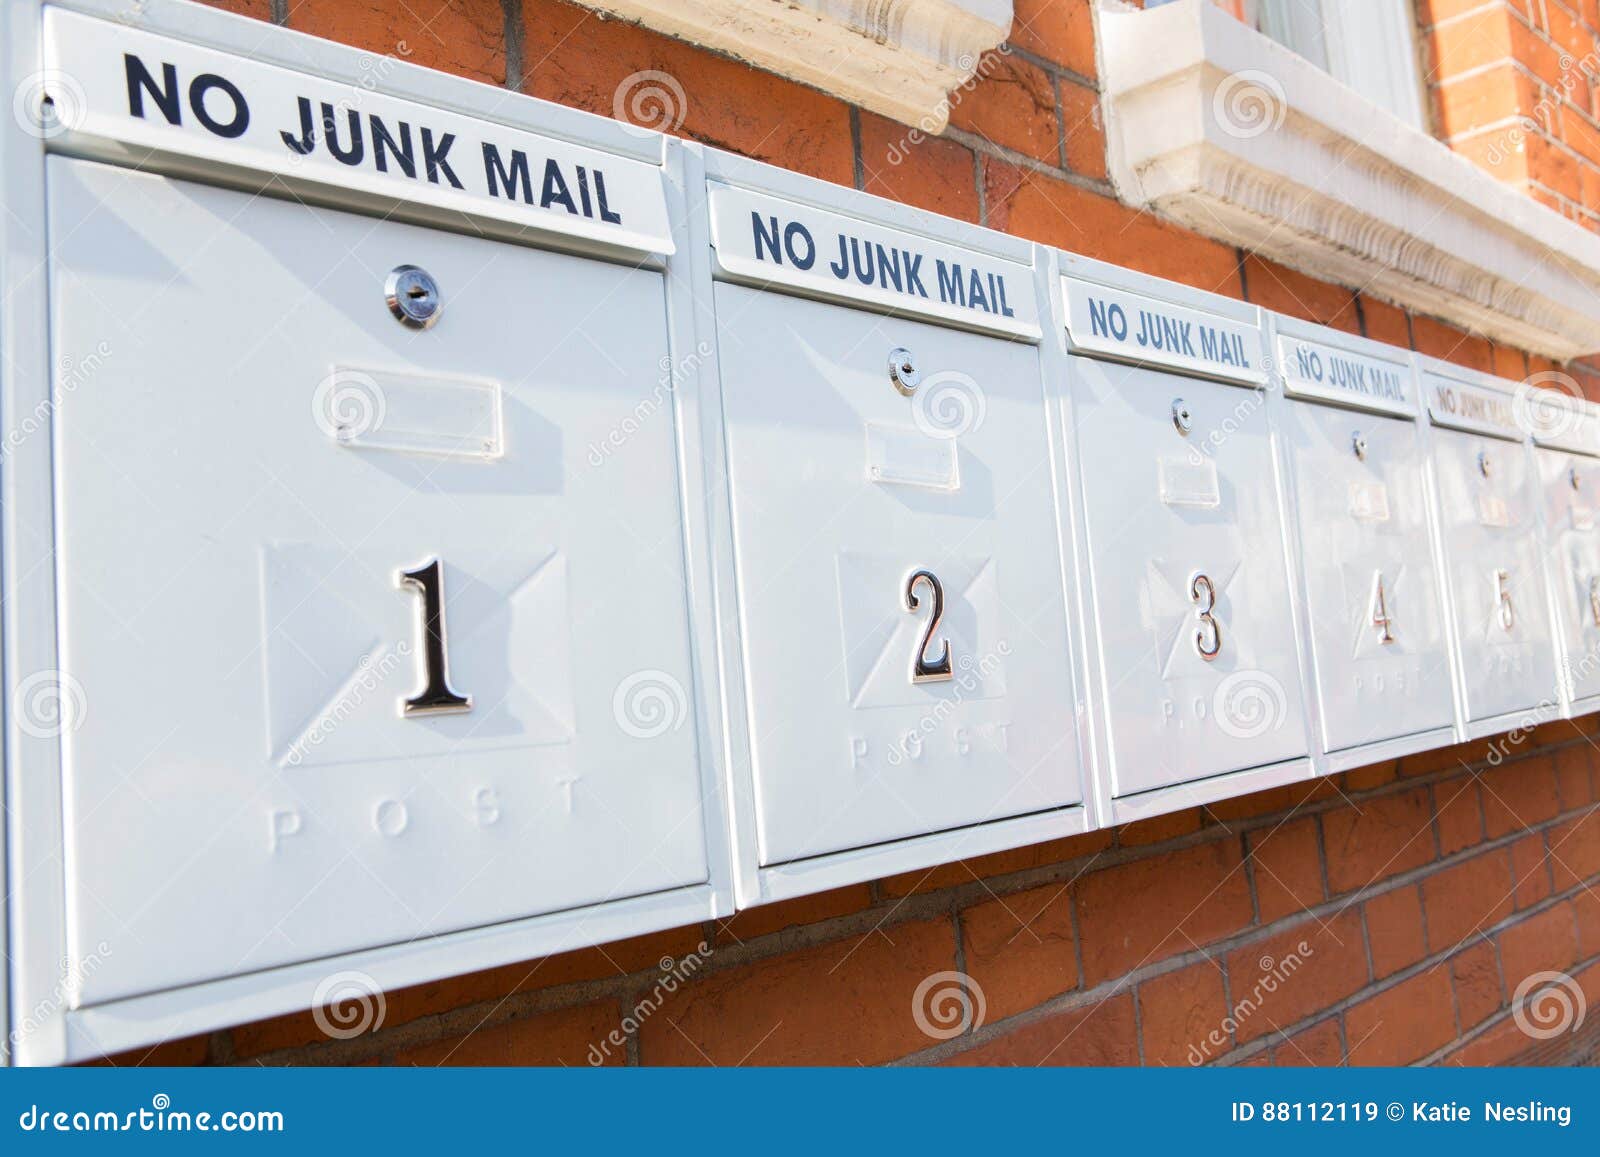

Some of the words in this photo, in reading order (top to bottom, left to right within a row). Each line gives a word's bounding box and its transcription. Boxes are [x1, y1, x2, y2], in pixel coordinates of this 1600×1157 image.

[124, 52, 251, 139] NO
[278, 95, 465, 192] JUNK
[480, 140, 623, 226] MAIL
[750, 210, 816, 271] NO
[829, 233, 930, 299] JUNK
[935, 258, 1015, 318] MAIL
[1087, 297, 1128, 342] NO
[1136, 310, 1196, 357] JUNK
[1199, 325, 1250, 369] MAIL
[1296, 345, 1323, 386] NO
[1329, 356, 1369, 394] JUNK
[1369, 367, 1406, 402] MAIL
[392, 554, 473, 718] 1
[899, 565, 954, 685] 2
[1186, 568, 1222, 662] 3
[1367, 567, 1396, 646] 4
[1492, 567, 1514, 633] 5
